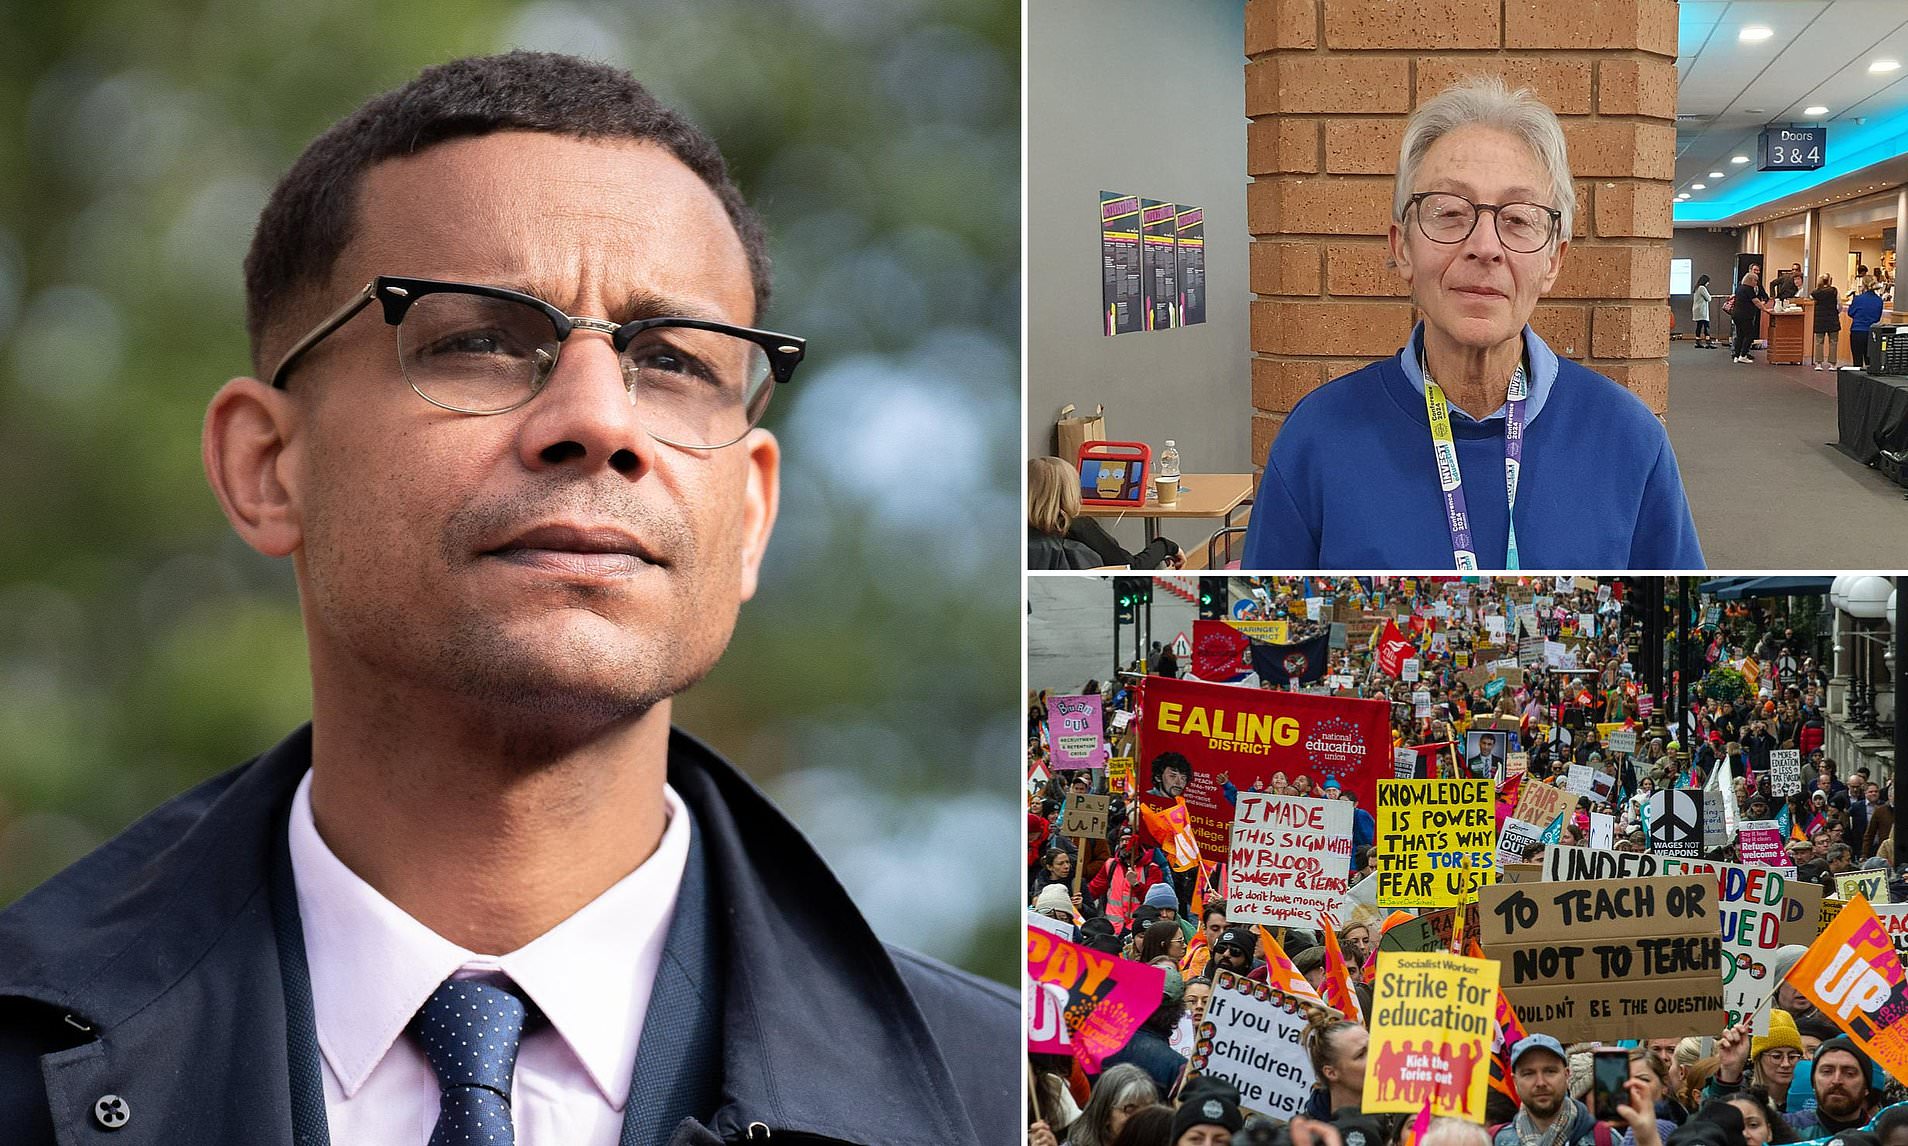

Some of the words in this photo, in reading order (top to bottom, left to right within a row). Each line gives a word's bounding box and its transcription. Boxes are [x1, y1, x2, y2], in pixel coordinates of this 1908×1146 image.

[1782, 130, 1813, 140] Doors
[1773, 146, 1784, 164] 3
[1790, 148, 1802, 164] &
[1807, 146, 1820, 163] 4
[1507, 403, 1515, 440] Conference
[1448, 493, 1458, 532] Conference
[1456, 512, 1464, 530] 2024
[1158, 701, 1300, 746] EALING
[1209, 738, 1271, 756] DISTRICT
[1306, 739, 1366, 754] education
[1322, 733, 1352, 741] national
[1195, 777, 1213, 785] PEACH
[1780, 766, 1793, 774] LESS
[1379, 782, 1489, 806] KNOWLEDGE
[1524, 782, 1558, 813] FAIR
[1240, 798, 1262, 823] I
[1264, 801, 1324, 830] MADE
[1392, 811, 1411, 832] IS
[1518, 803, 1544, 826] PAY
[1235, 829, 1275, 846] THIS
[1280, 833, 1325, 852] SIGN
[1328, 836, 1352, 856] WITH
[1384, 830, 1448, 852] THAT'S
[1456, 831, 1493, 847] WHY
[1505, 832, 1536, 845] TORIES
[1742, 842, 1778, 851] Refugees
[1232, 848, 1254, 868] MY
[1379, 854, 1418, 871] THE
[1427, 852, 1493, 869] TORES
[1232, 869, 1293, 888] SWEAT
[1295, 872, 1307, 890] &
[1309, 870, 1348, 895] TEARS
[1380, 872, 1434, 896] FEAR
[1230, 886, 1243, 900] We
[1246, 890, 1268, 901] don't
[1270, 891, 1292, 904] have
[1293, 896, 1324, 911] money
[1327, 898, 1342, 911] for
[1234, 904, 1258, 914] art
[1494, 890, 1539, 934] TO
[1553, 885, 1655, 926] TEACH
[1666, 883, 1706, 919] OR
[1398, 959, 1441, 969] Socialist
[1442, 960, 1480, 974] Worker
[1513, 946, 1584, 984] NOT
[1593, 945, 1632, 978] TO
[1637, 938, 1722, 976] TEACH
[1848, 916, 1908, 1003] PA
[1381, 973, 1448, 998] Strike
[1457, 978, 1491, 1006] for
[1814, 944, 1892, 1020] UP
[1208, 996, 1226, 1016] If
[1228, 1007, 1270, 1033] you
[1590, 999, 1611, 1018] BE
[1620, 998, 1648, 1016] THE
[1654, 996, 1724, 1014] QUESTION
[1378, 1004, 1488, 1036] education
[1215, 1040, 1308, 1088] children,
[1406, 1054, 1428, 1068] Kick
[1432, 1055, 1449, 1070] the
[1400, 1066, 1432, 1083] Tories
[1435, 1071, 1453, 1084] out
[1269, 1091, 1304, 1114] us!
